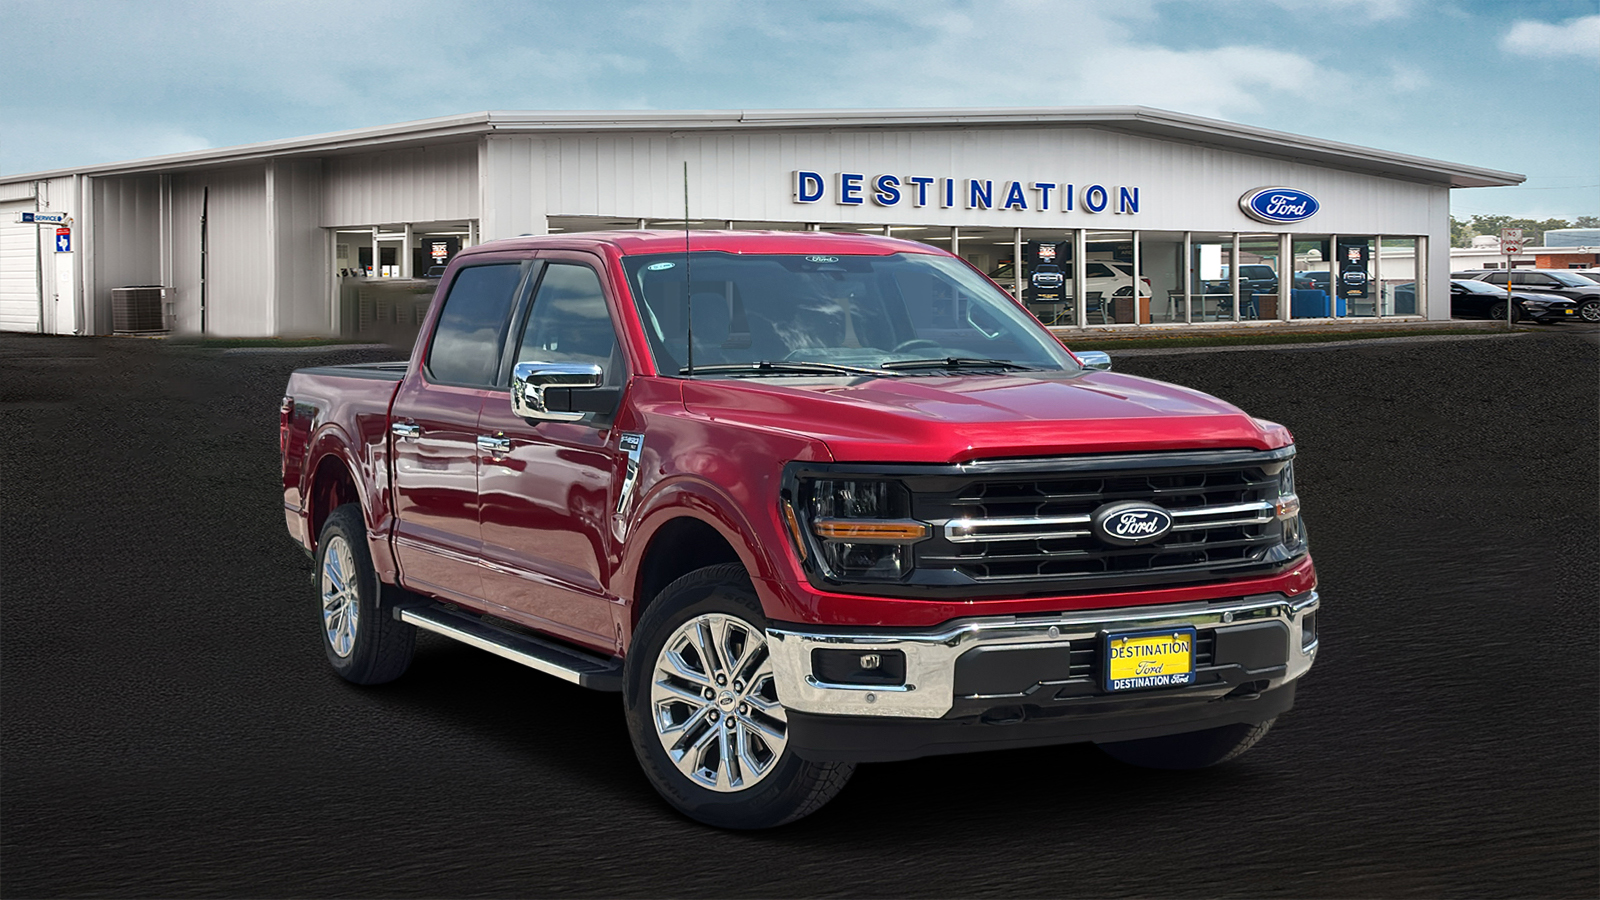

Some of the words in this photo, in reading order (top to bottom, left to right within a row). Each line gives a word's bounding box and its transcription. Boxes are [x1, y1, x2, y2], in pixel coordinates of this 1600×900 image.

[796, 169, 1140, 215] DESTINATION
[1266, 194, 1307, 216] Ford
[1116, 512, 1158, 535] Ford
[1111, 641, 1189, 659] DESTINATION
[1135, 660, 1164, 675] Ford
[1114, 676, 1169, 689] DESTINATION
[1171, 674, 1189, 683] Ford
